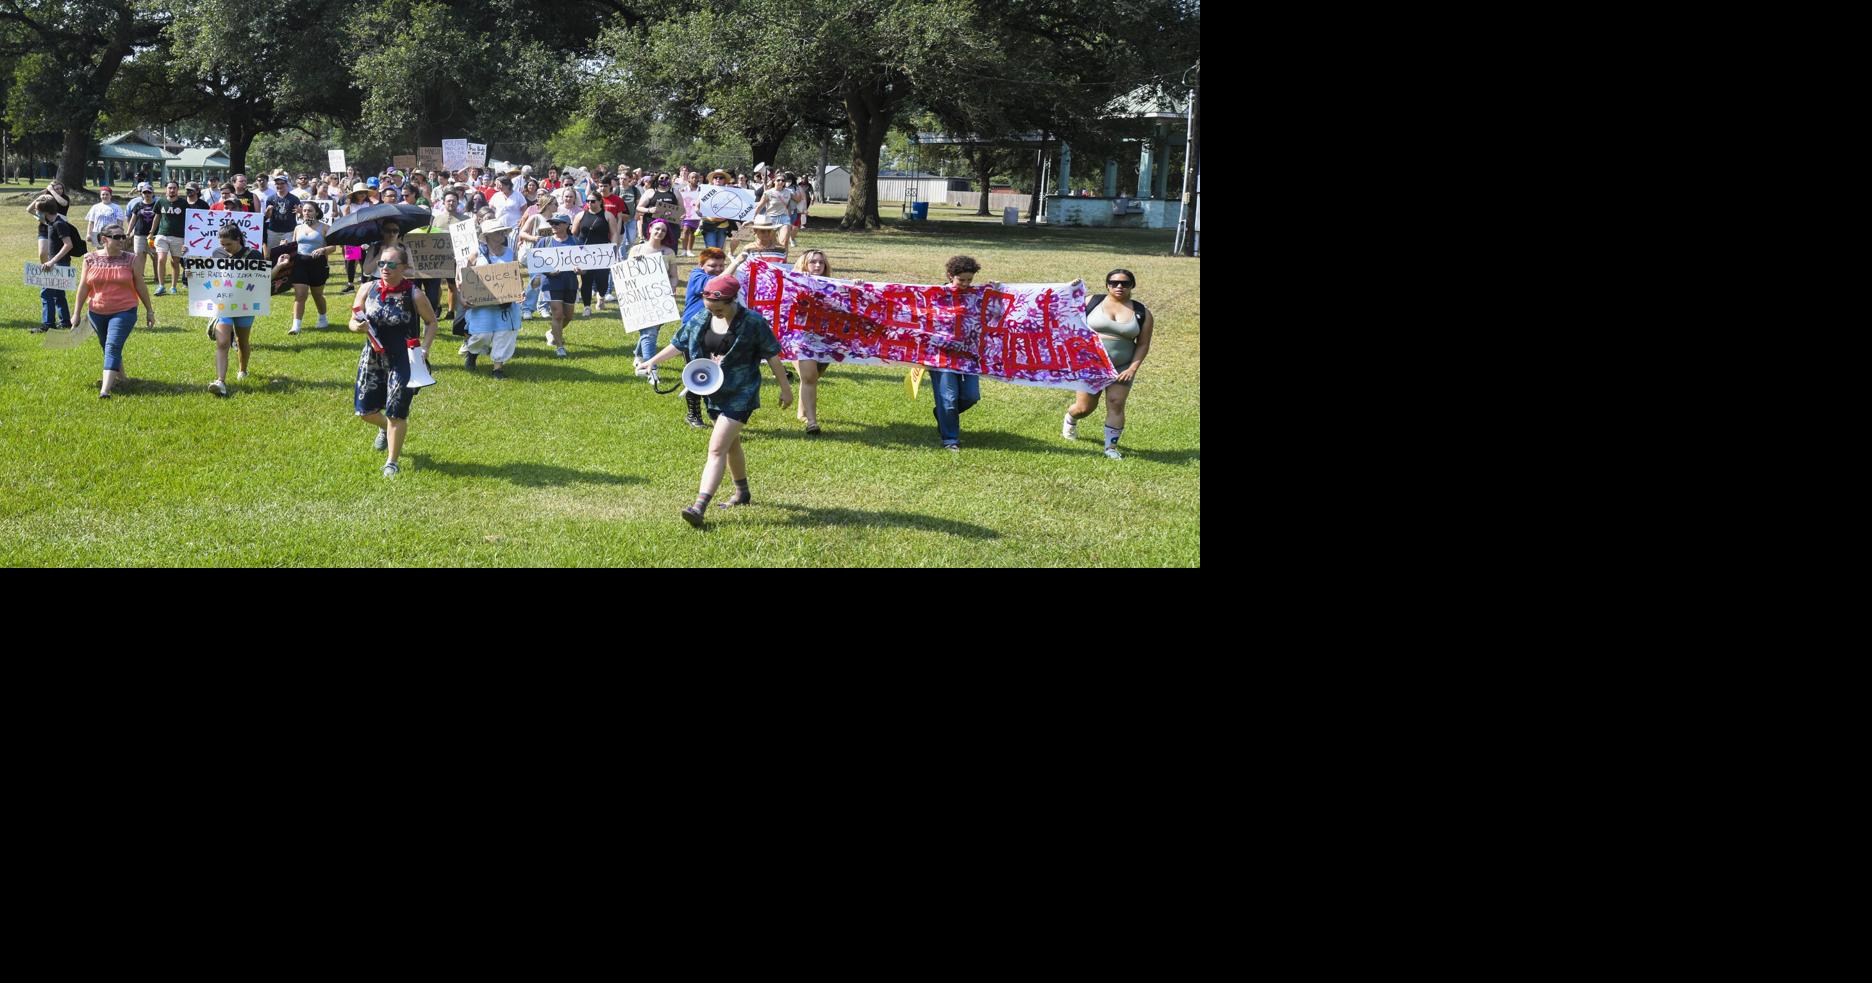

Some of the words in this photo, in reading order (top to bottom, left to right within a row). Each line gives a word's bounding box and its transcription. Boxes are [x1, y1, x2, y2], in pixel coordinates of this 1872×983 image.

[701, 189, 717, 202] NEVER
[738, 204, 754, 219] AGAIN
[207, 218, 214, 226] I
[456, 223, 466, 232] MY
[462, 246, 470, 256] MY
[186, 258, 214, 270] PRO
[627, 255, 664, 278] BODY
[625, 279, 637, 290] MY
[196, 302, 260, 310] PEOPLE
